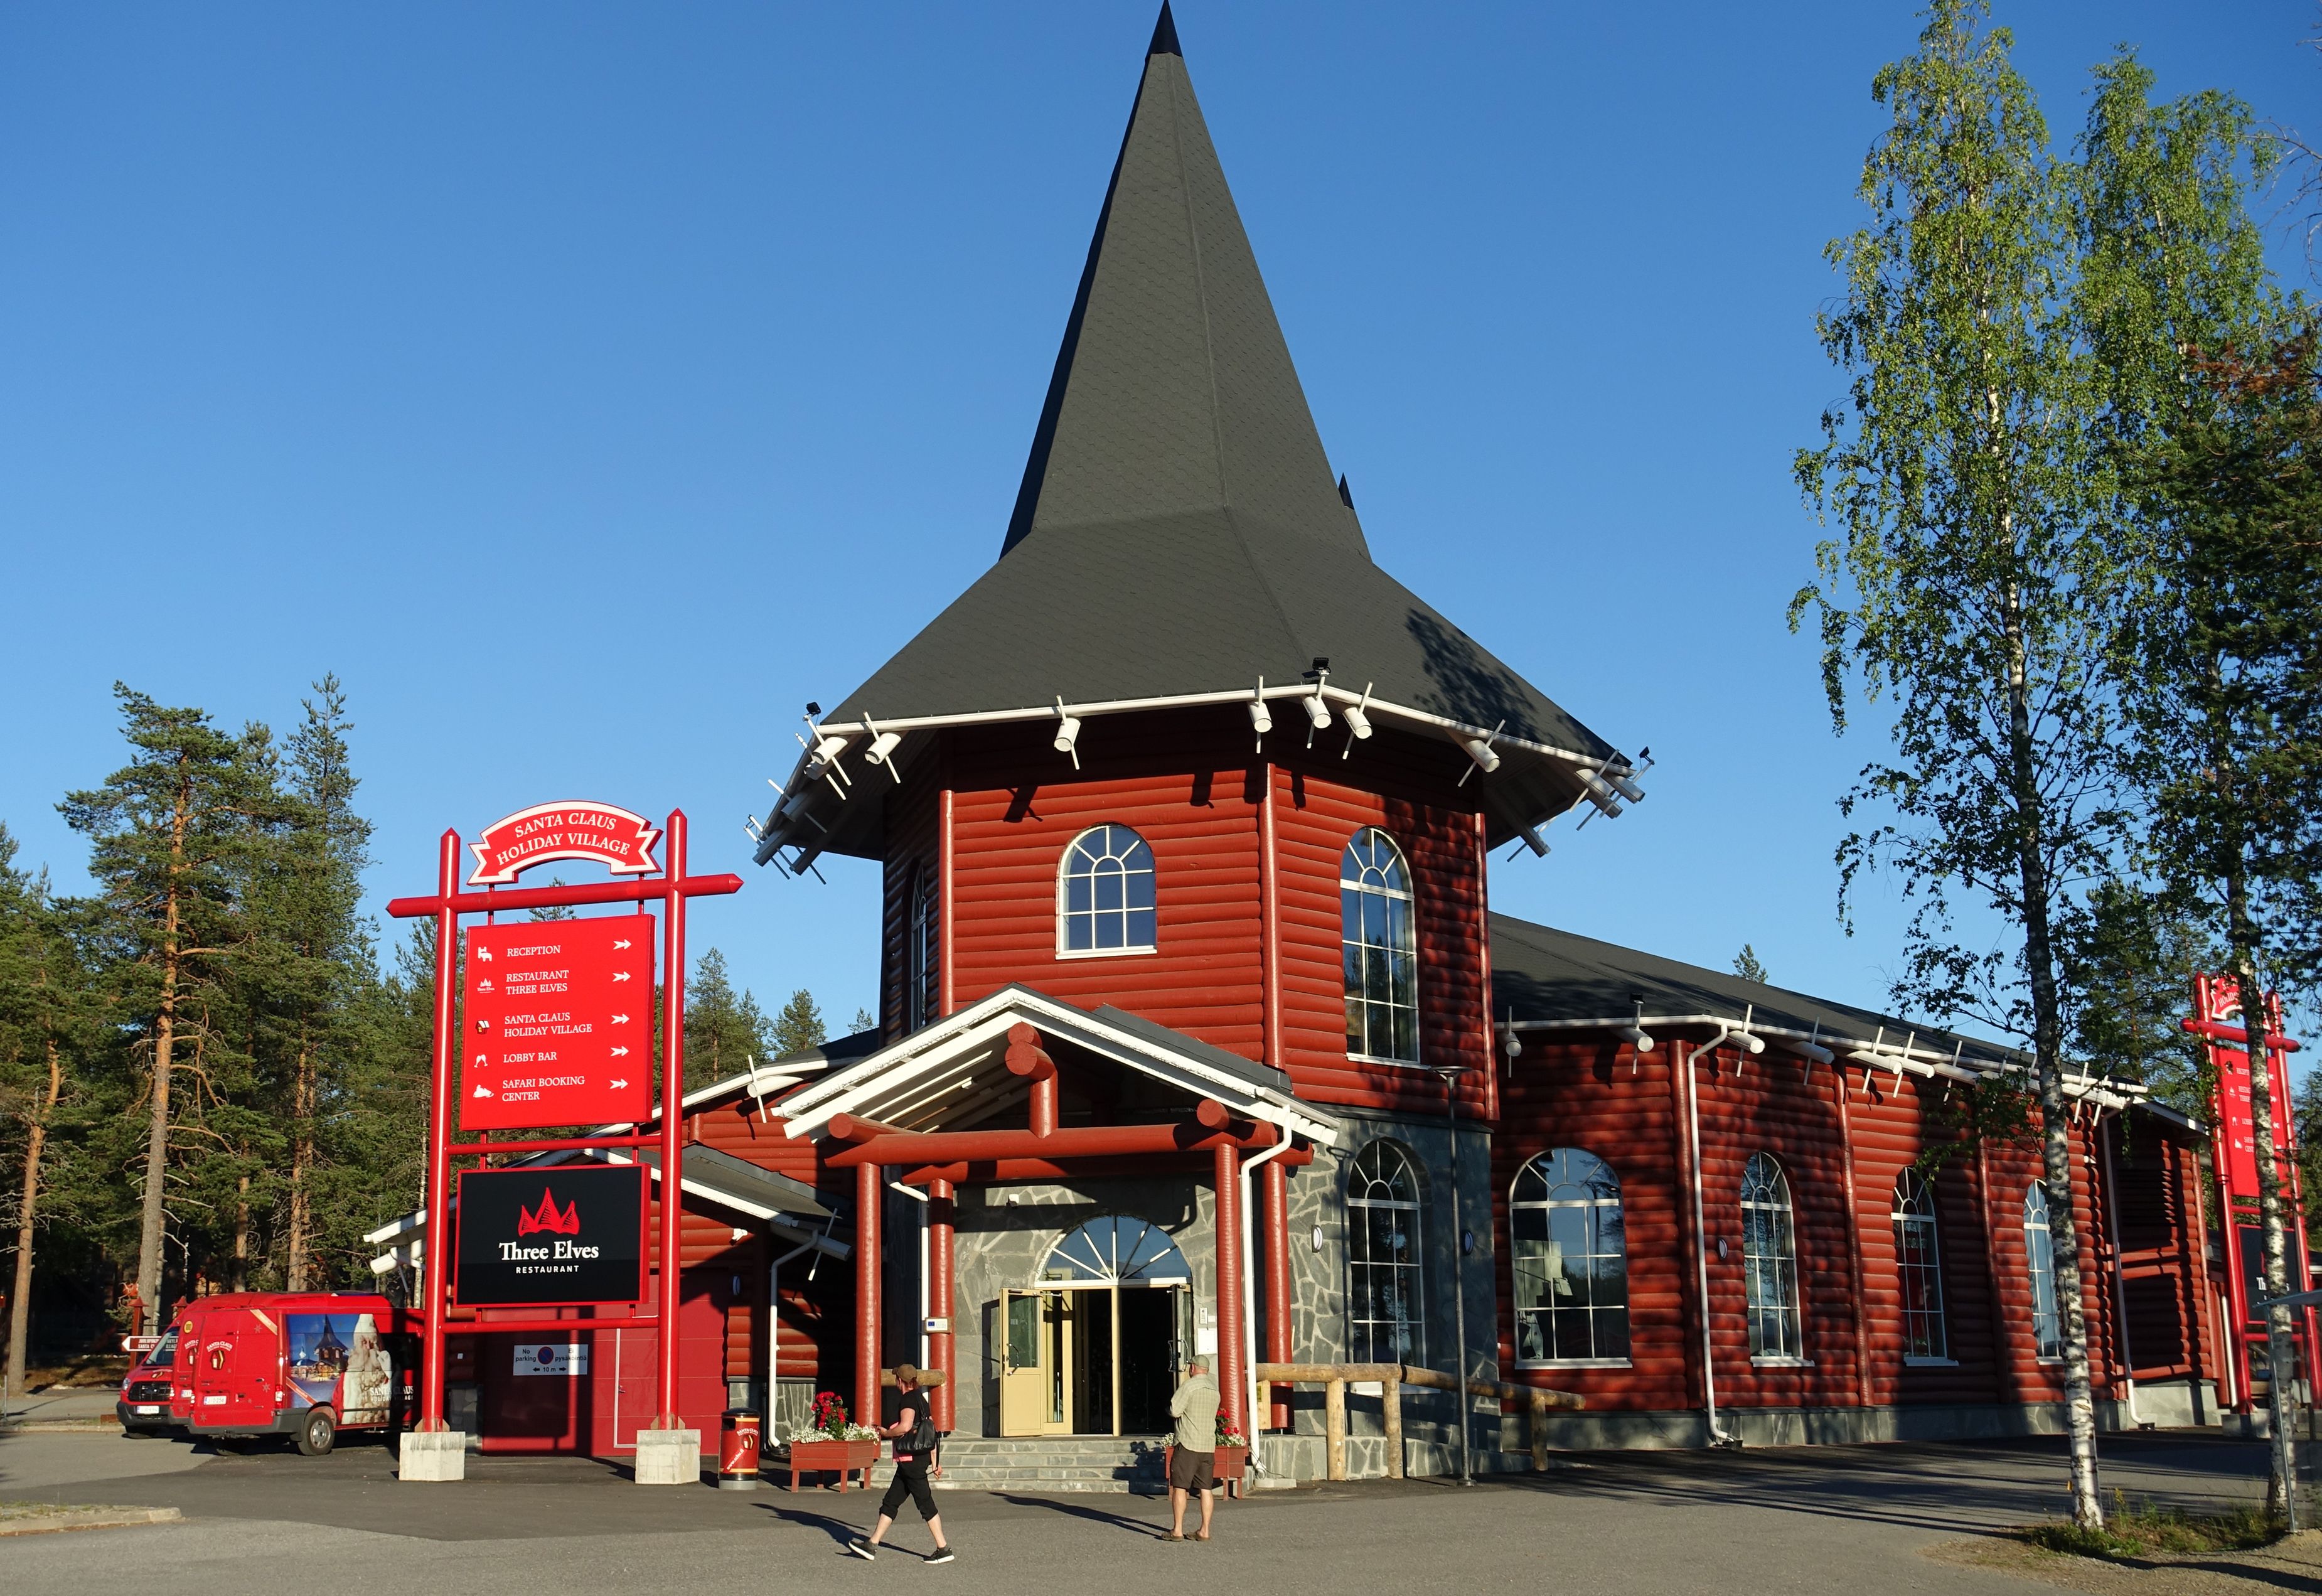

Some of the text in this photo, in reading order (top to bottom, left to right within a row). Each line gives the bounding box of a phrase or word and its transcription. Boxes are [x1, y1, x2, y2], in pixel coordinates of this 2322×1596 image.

[515, 813, 617, 838] SANTA CLAUS
[496, 833, 631, 865] HOLIDAY VILLAGE
[506, 945, 561, 956] RECEPTION
[506, 970, 569, 982] RESTAURANT
[506, 983, 568, 995] THREE ELVES
[505, 1012, 570, 1024] SANTA CLAUS
[504, 1024, 592, 1037] HOLIDAY VILLAGE
[503, 1052, 557, 1063] LOBBY BAR
[503, 1076, 586, 1089] SAFARI BOOKING
[502, 1091, 540, 1101] CENTER
[498, 1240, 599, 1260] Three Elves
[516, 1265, 579, 1274] RESTAURANT
